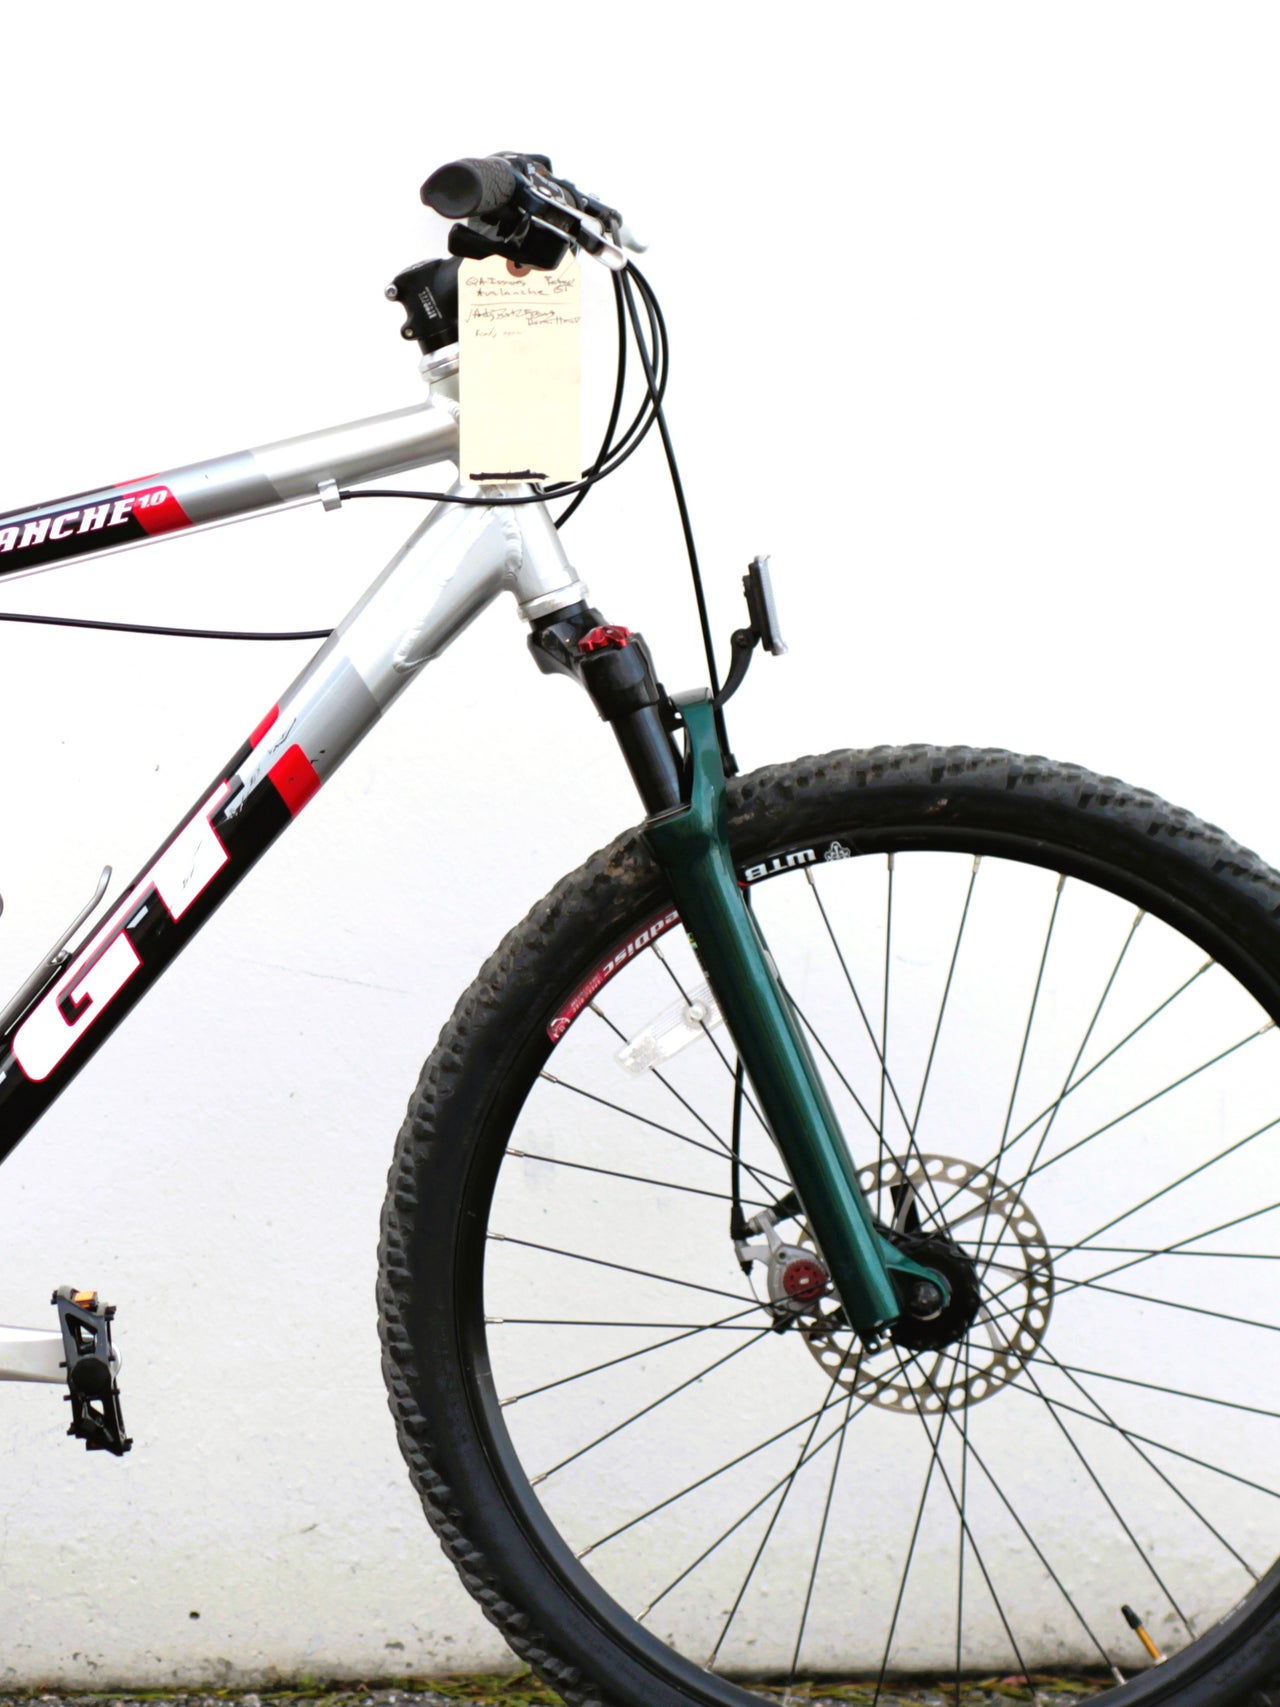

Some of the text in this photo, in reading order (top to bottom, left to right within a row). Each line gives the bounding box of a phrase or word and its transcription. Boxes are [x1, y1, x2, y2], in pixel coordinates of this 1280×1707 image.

[11, 777, 231, 1083] GT
[601, 848, 817, 978] WTB edDisc
